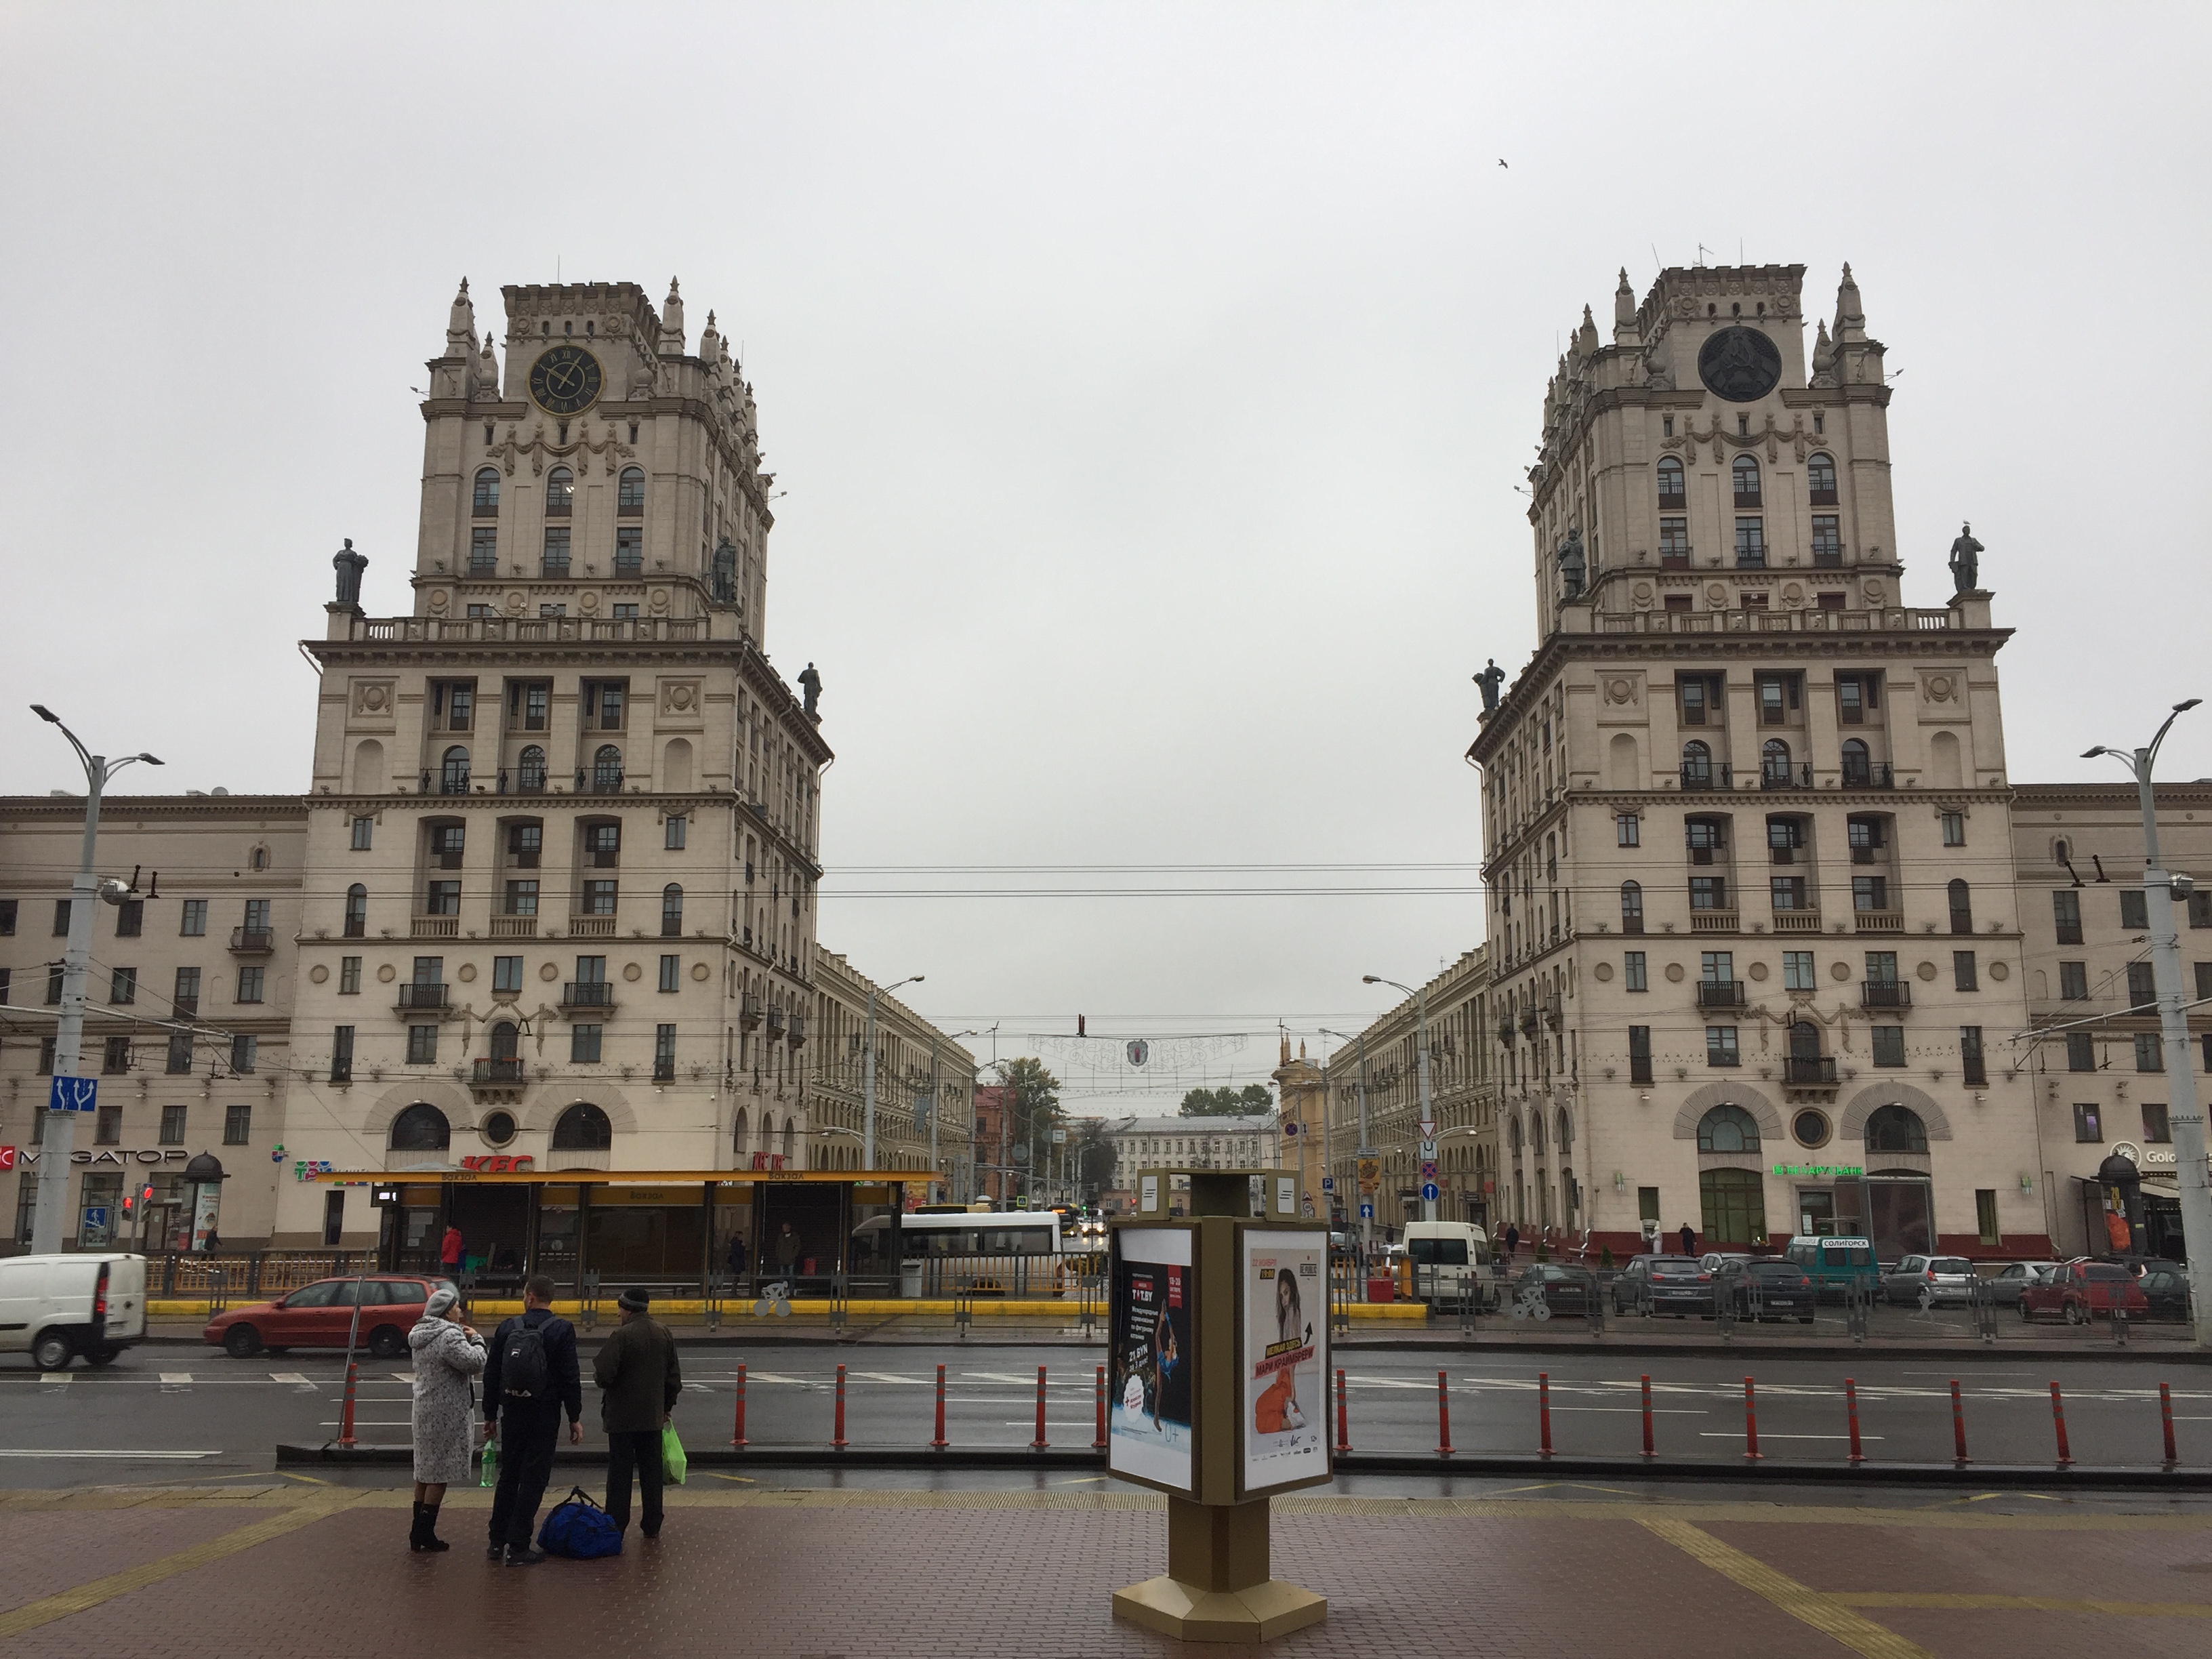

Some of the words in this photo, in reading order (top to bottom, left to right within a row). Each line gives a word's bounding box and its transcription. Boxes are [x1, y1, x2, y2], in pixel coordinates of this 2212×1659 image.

[19, 1151, 190, 1165] MGATOP
[464, 1155, 533, 1172] KFC
[1786, 1166, 1863, 1175] БЕЛАРУСБАНК
[630, 1191, 663, 1200] Вакзал
[1129, 1351, 1135, 1362] 21
[1255, 1361, 1273, 1377] МАРИ
[1274, 1347, 1314, 1370] КРАЙМБРЕРИ
[1166, 1423, 1179, 1442] 0+
